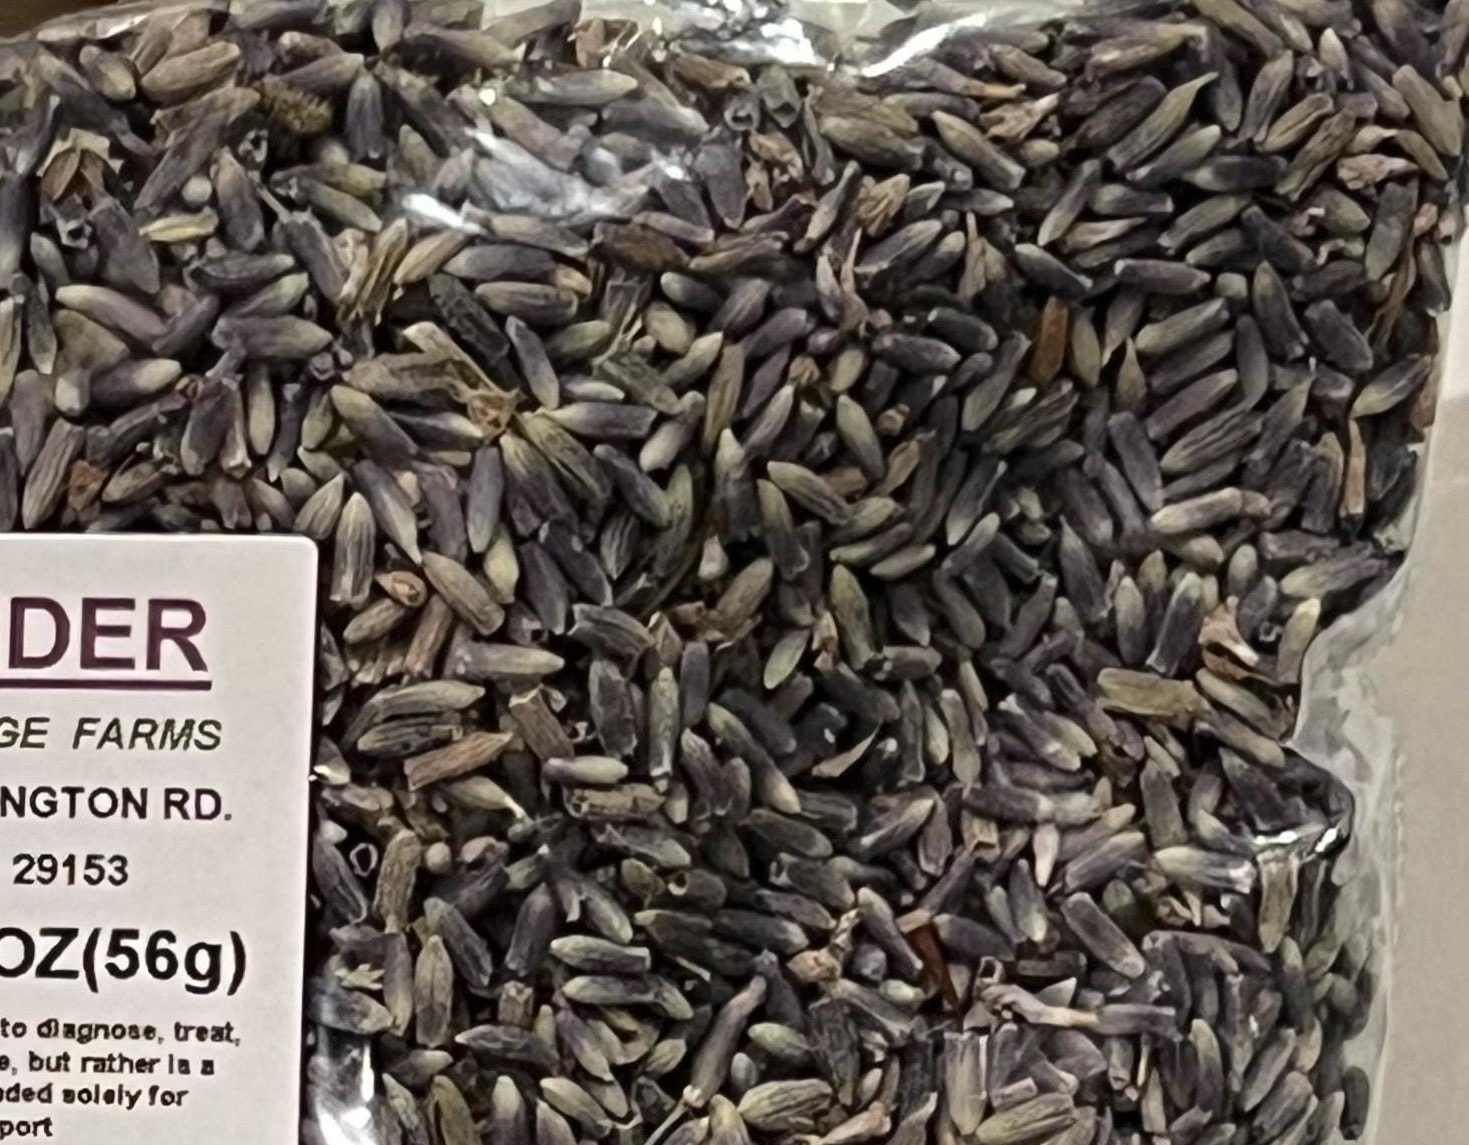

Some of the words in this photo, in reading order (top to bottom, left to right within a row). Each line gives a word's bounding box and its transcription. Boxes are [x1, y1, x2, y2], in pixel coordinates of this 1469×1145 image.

[72, 717, 222, 751] FARMS
[163, 787, 232, 821] RD.
[12, 853, 129, 887] 29153
[0, 1017, 28, 1039] to
[36, 1018, 164, 1045] diagnose,
[173, 1021, 240, 1047] treat,
[28, 1050, 71, 1073] but
[80, 1052, 161, 1074] rather
[168, 1053, 191, 1075] is
[200, 1059, 215, 1076] a
[62, 1083, 143, 1111] solely
[148, 1084, 189, 1107] for
